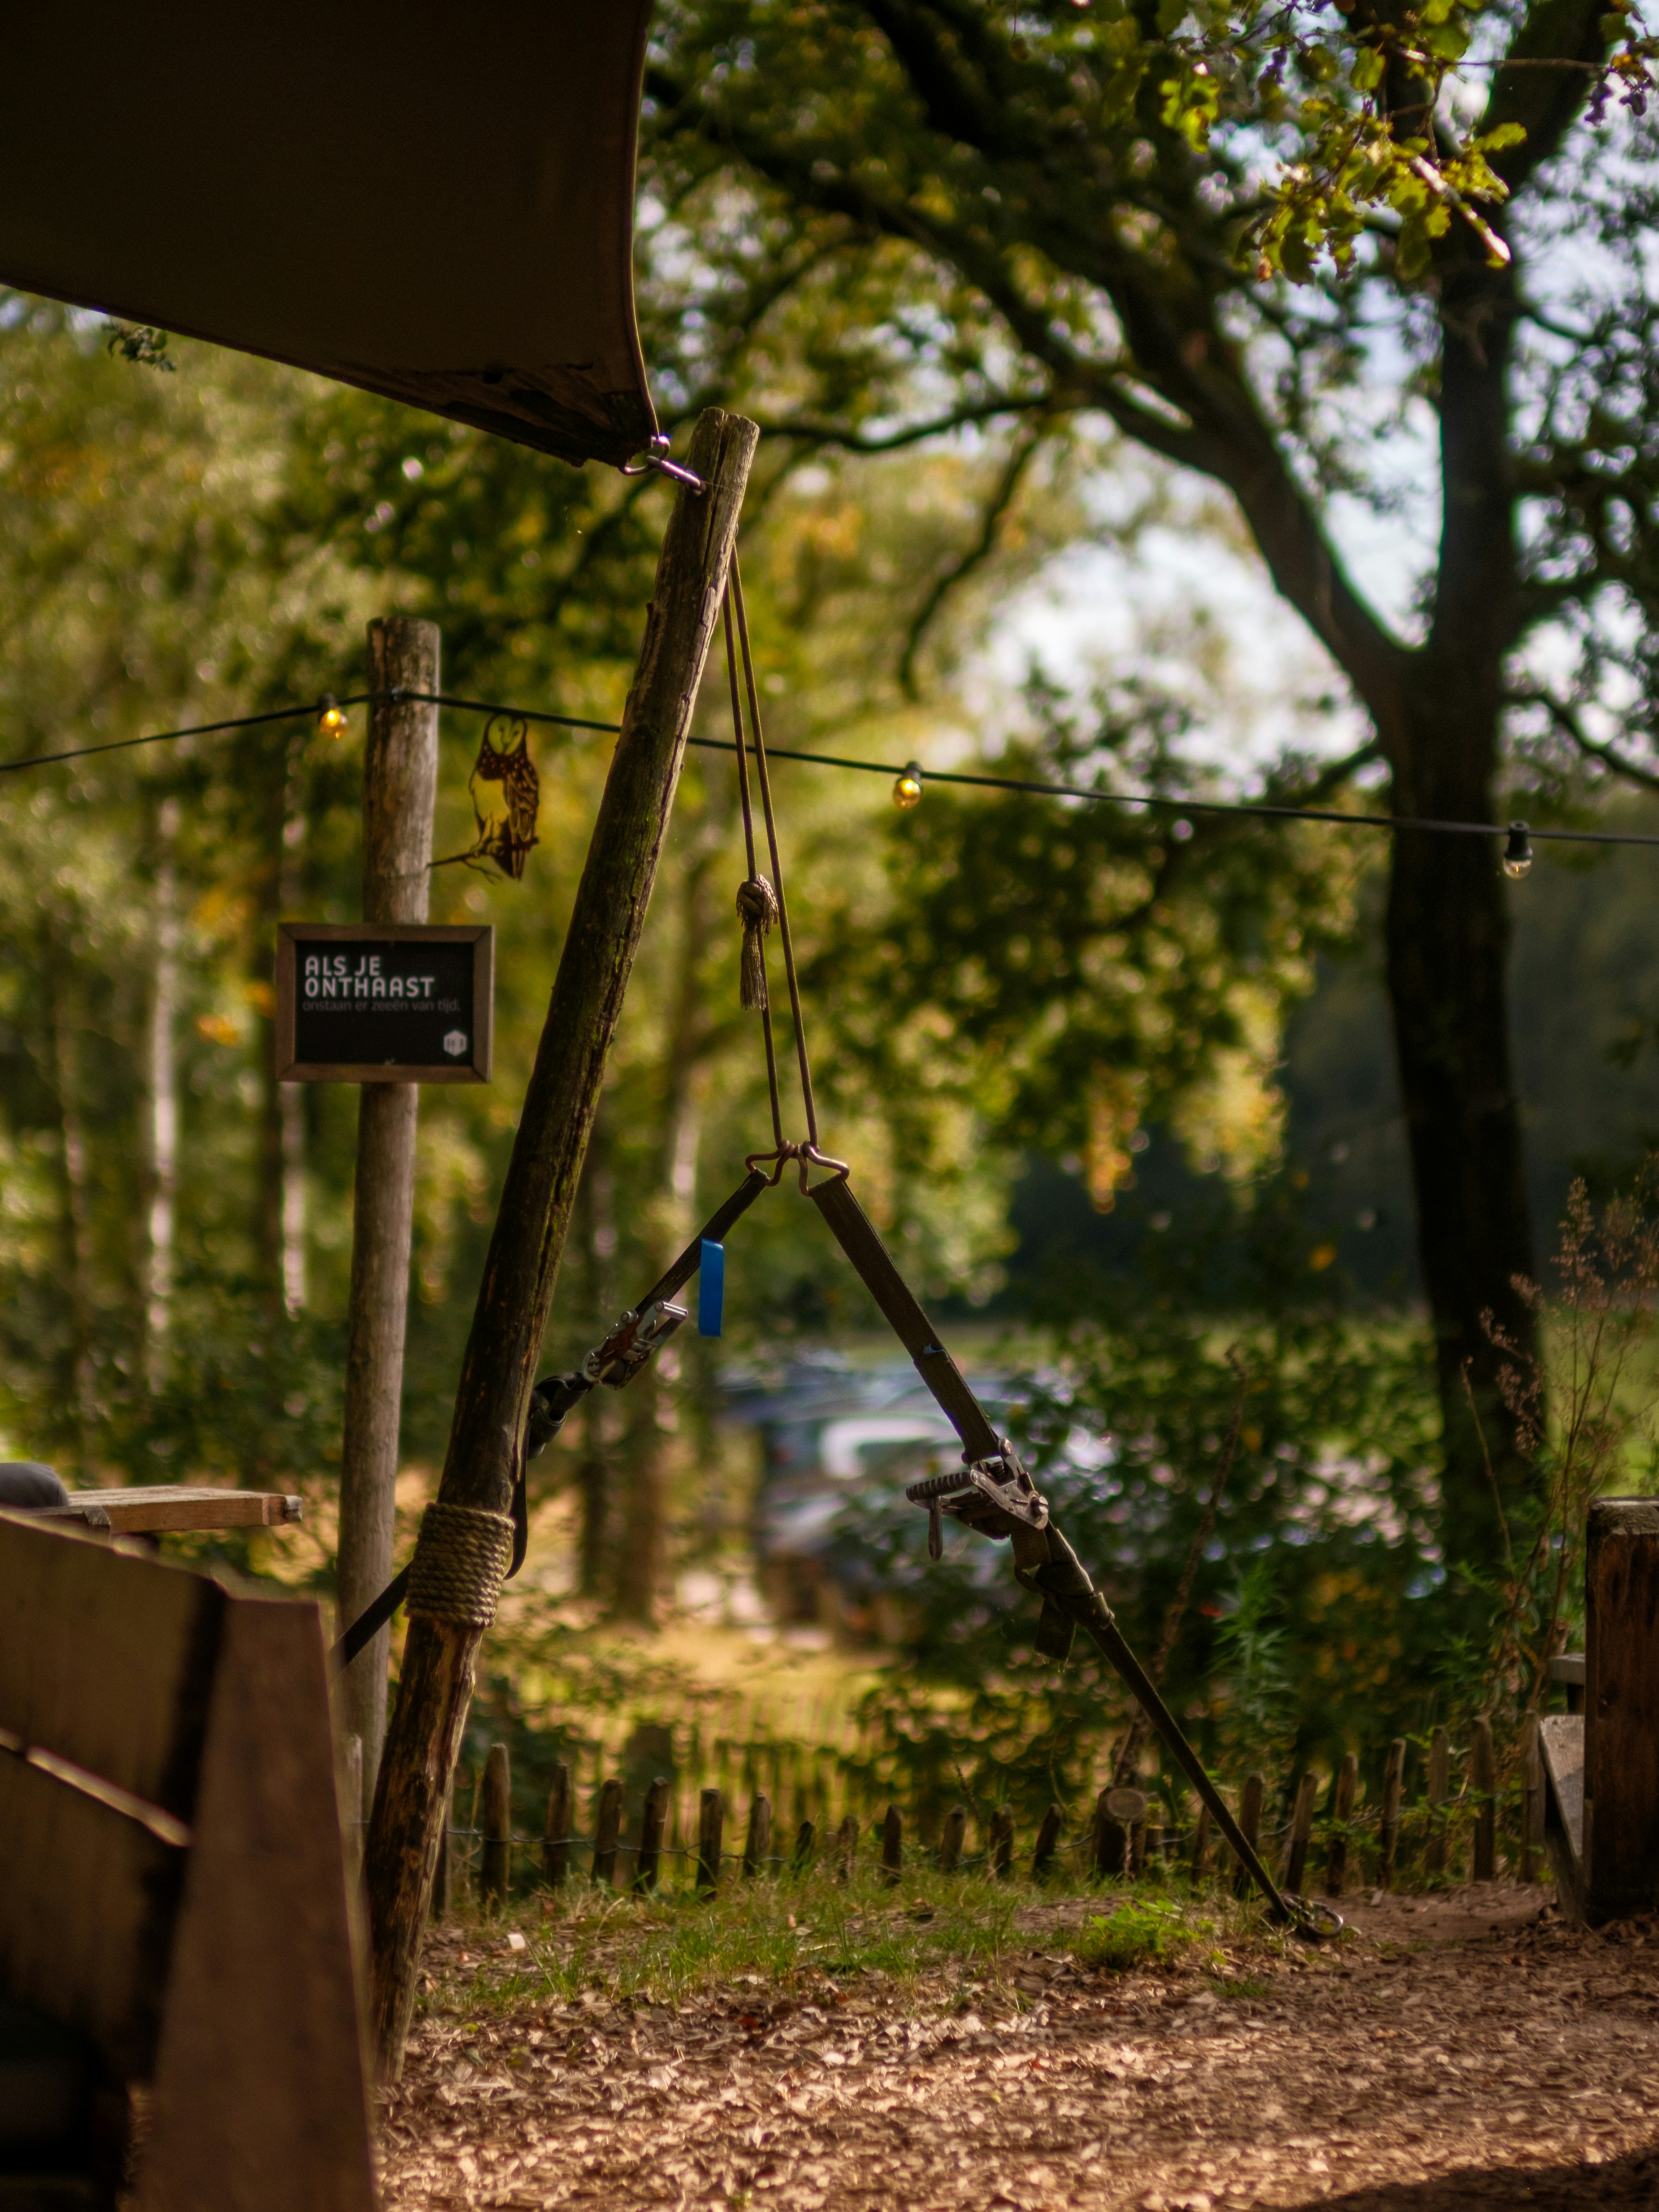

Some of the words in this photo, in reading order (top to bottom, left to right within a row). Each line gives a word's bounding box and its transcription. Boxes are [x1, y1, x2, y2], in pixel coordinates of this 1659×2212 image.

[305, 955, 347, 976] ALS
[355, 955, 381, 976] JE
[305, 977, 434, 997] ONTHAAST
[355, 1001, 368, 1011] er
[412, 1001, 434, 1011] van
